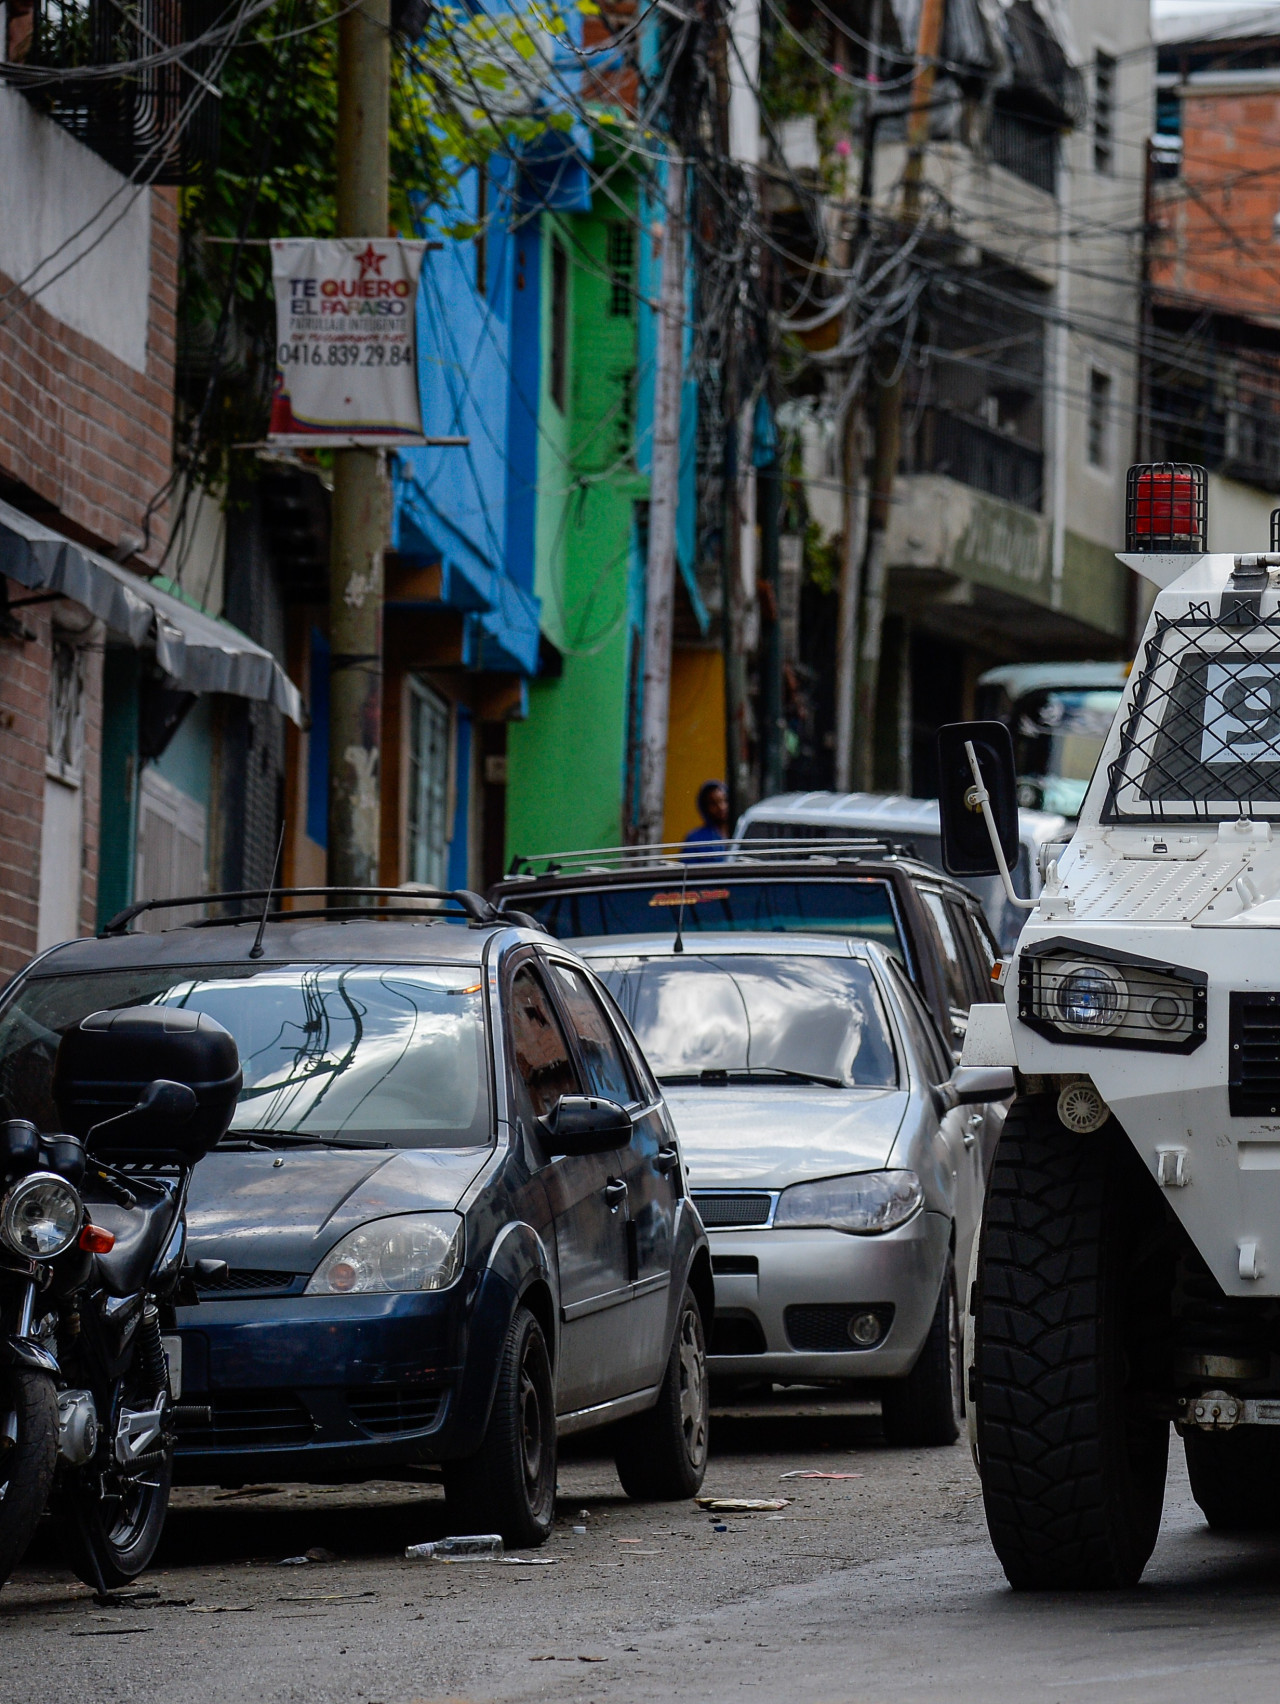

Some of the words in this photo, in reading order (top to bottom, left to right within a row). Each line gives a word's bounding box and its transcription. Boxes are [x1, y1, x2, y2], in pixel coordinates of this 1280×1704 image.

[289, 279, 317, 297] TE
[320, 279, 409, 298] QUIERO
[291, 299, 317, 315] EL
[279, 344, 413, 366] 0416.839.29.84
